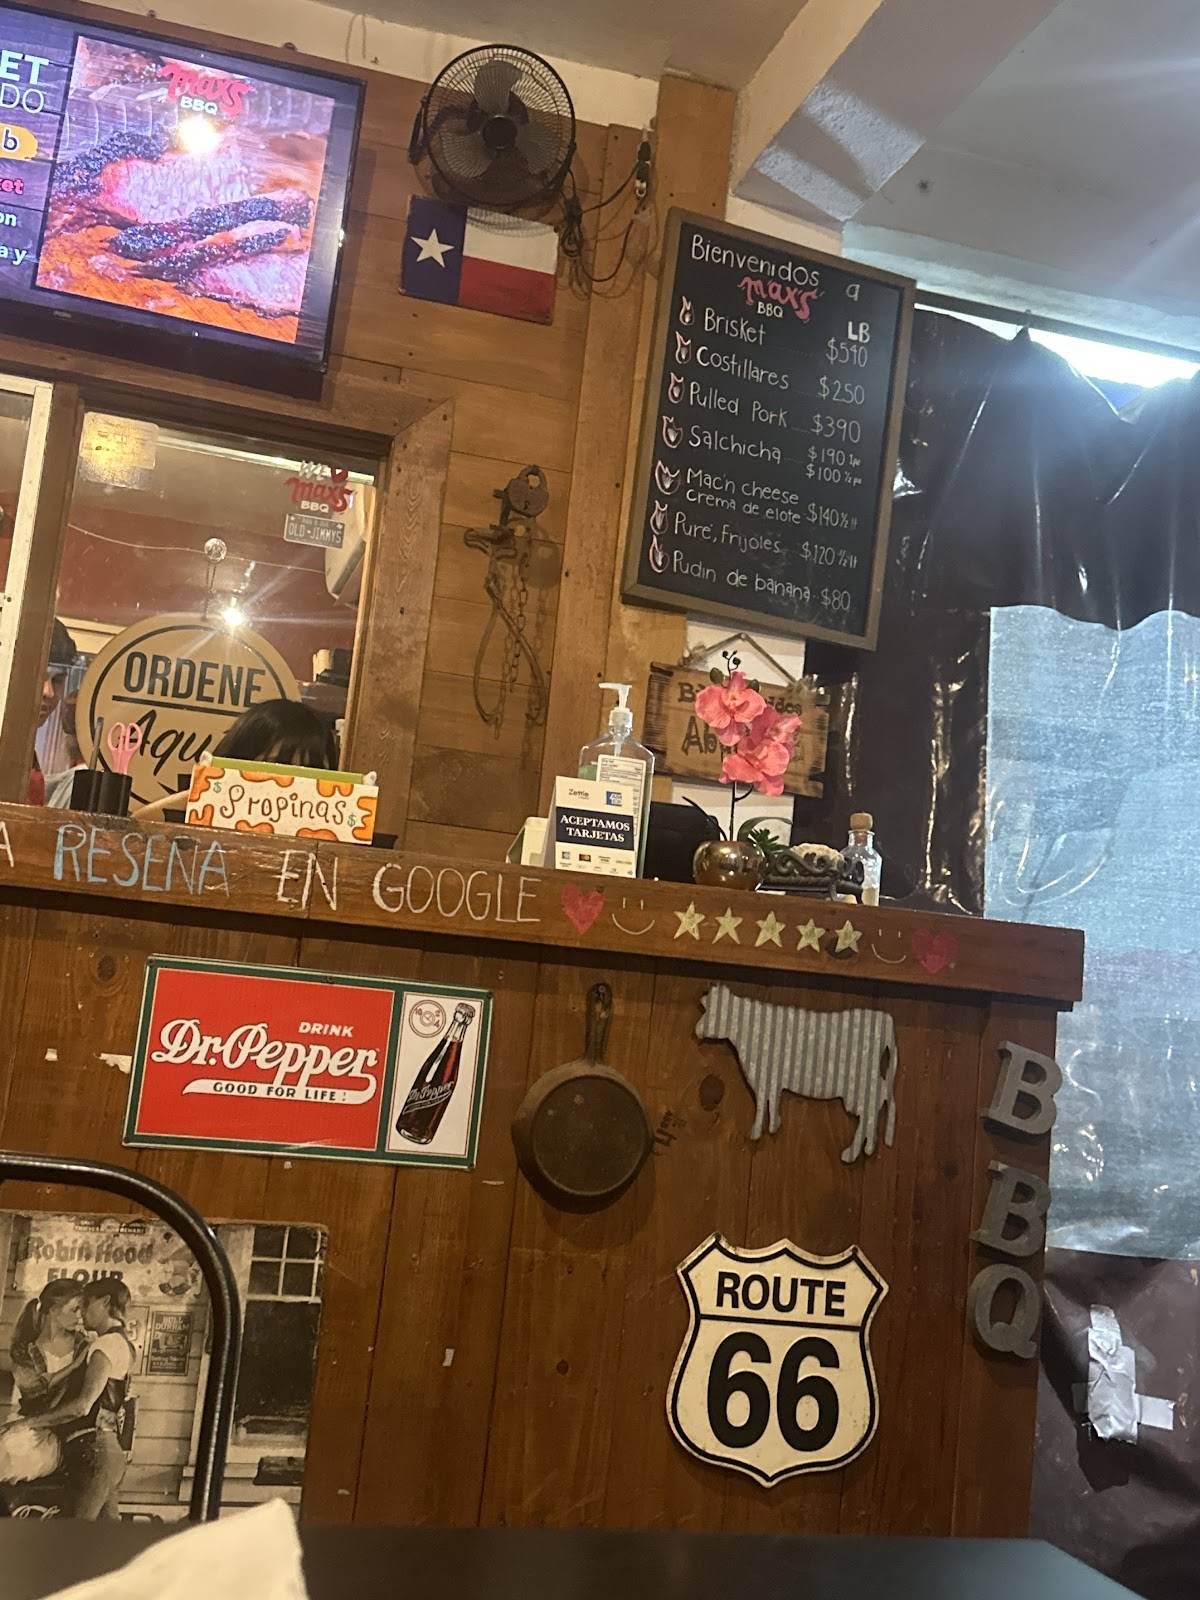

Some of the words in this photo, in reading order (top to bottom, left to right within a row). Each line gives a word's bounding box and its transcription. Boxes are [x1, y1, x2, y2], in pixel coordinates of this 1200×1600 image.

[180, 96, 218, 115] BBQ
[691, 233, 820, 287] Bienvenidos
[704, 307, 766, 345] Brisket
[757, 301, 783, 318] BBQ
[847, 321, 870, 343] LB
[696, 346, 789, 389] Costillares
[817, 375, 865, 404] $250
[689, 381, 739, 415] Pulled
[751, 401, 789, 429] Pork
[811, 414, 861, 443] $390
[688, 425, 782, 464] Salchicha
[807, 446, 846, 466] $190
[805, 463, 841, 483] $100
[301, 500, 330, 512] BBQ
[686, 489, 737, 511] Crema
[742, 502, 760, 515] de
[766, 507, 801, 525] elote
[806, 502, 839, 526] $140
[741, 480, 799, 505] cheese
[726, 569, 748, 588] de
[754, 572, 811, 603] banana
[820, 587, 851, 611] $80
[123, 650, 266, 707] ORDENE
[118, 708, 213, 776] Aqu
[220, 785, 346, 826] Propinas
[560, 814, 631, 832] ACEPTAMOS
[566, 826, 625, 843] TARJETAS
[275, 848, 340, 912] EN
[372, 862, 542, 923] GOOGLE
[298, 1021, 354, 1038] DRINK
[212, 1081, 258, 1096] GOOD
[266, 1085, 297, 1098] FOR
[715, 1271, 847, 1317] ROUTE
[706, 1330, 841, 1453] 66
